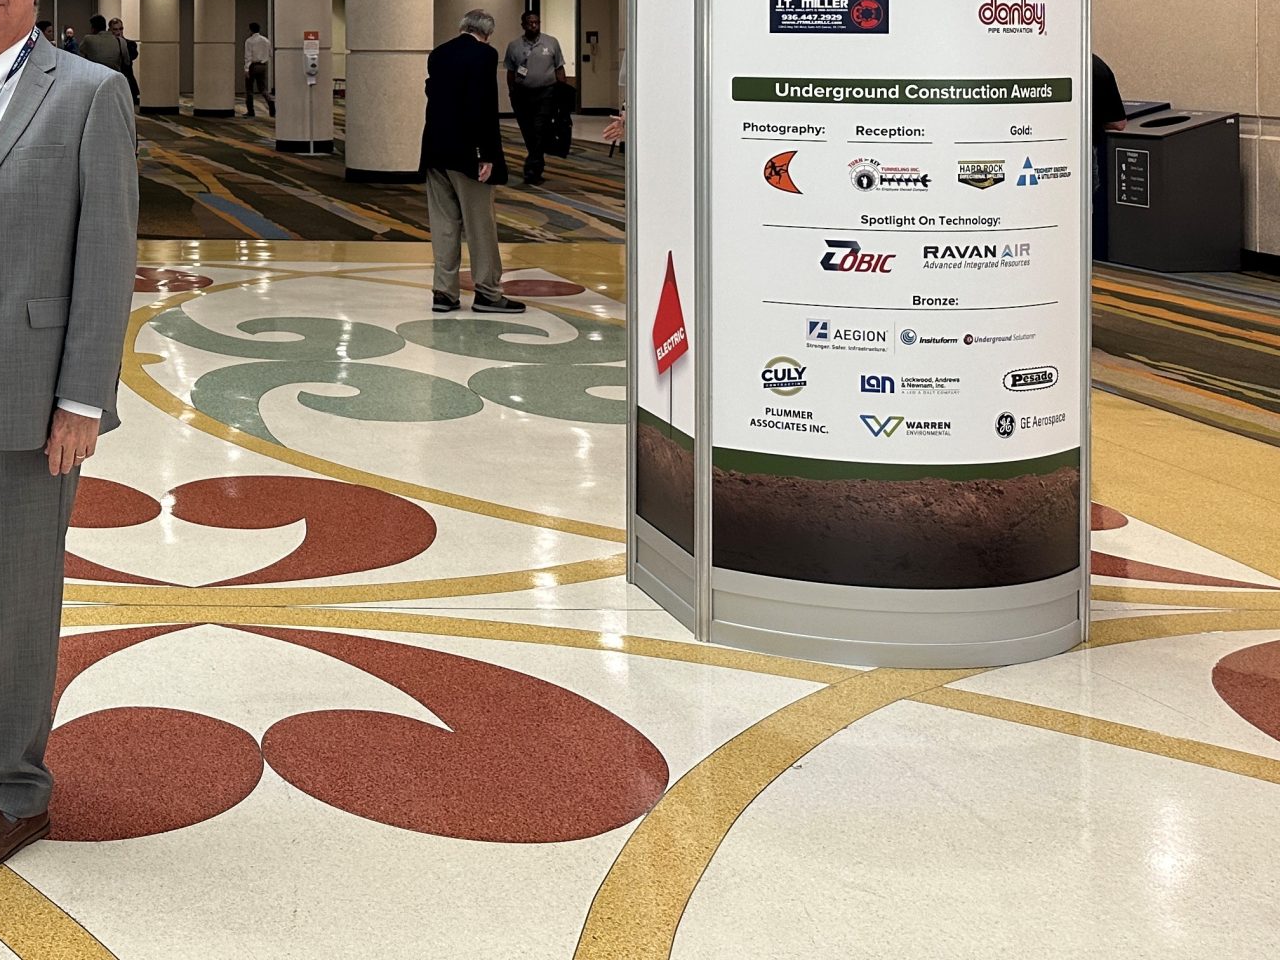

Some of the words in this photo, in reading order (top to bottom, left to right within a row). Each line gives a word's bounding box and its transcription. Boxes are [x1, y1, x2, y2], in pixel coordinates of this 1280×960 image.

[776, 0, 795, 8] J.T.
[801, 0, 849, 8] MILLER
[775, 83, 899, 101] Underground
[904, 83, 1007, 100] Construction
[1011, 83, 1053, 98] Awards
[742, 122, 826, 136] Photography:
[855, 125, 925, 138] Reception:
[1010, 125, 1033, 136] Gold:
[848, 157, 863, 168] TURN
[869, 158, 881, 167] KEY
[960, 165, 981, 173] HARD
[984, 164, 1003, 172] ROCK
[861, 214, 916, 226] Spotlight
[919, 215, 935, 225] On
[939, 215, 1000, 227] Technology:
[923, 246, 996, 258] RAVAN
[1001, 243, 1030, 257] AIR
[923, 260, 961, 270] Advanced
[964, 259, 997, 270] Integrated
[999, 259, 1030, 269] Resources
[913, 296, 958, 306] Bronze:
[833, 329, 886, 342] AEGION
[974, 335, 1012, 343] Underground
[656, 327, 685, 360] ELECTRIC
[761, 367, 807, 382] CULY
[1011, 371, 1053, 387] Pesado
[765, 407, 813, 419] PLUMMER
[750, 419, 807, 432] ASSOCIATES
[810, 424, 829, 434] INC.
[1021, 416, 1031, 429] GE
[1032, 413, 1065, 427] Aerospace
